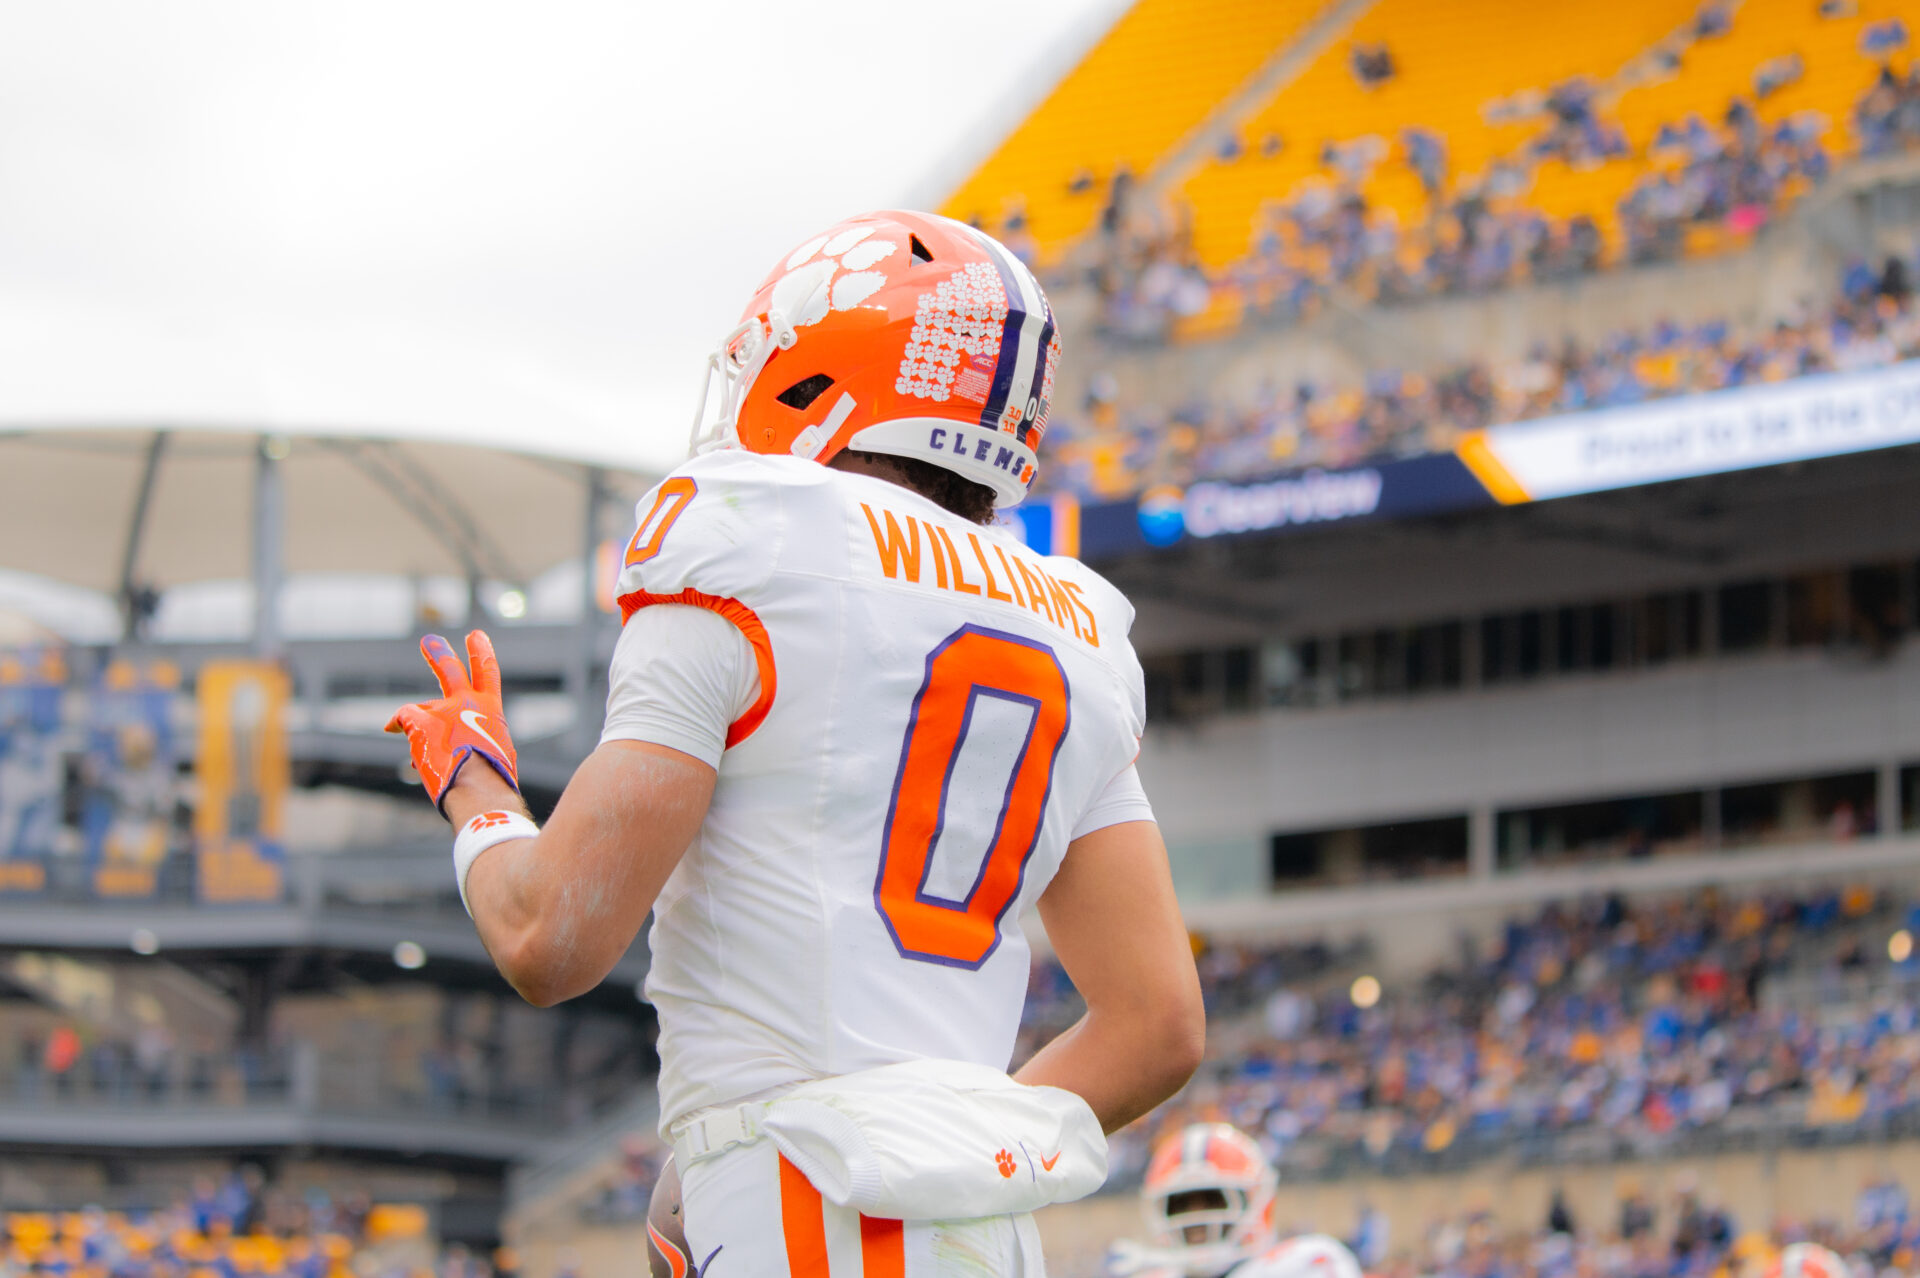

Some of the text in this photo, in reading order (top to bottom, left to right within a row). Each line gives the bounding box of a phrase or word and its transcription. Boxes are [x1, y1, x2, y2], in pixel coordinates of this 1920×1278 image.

[974, 357, 994, 368] ACC
[1025, 397, 1038, 422] 0
[625, 476, 698, 569] 0
[1184, 468, 1383, 538] Clearview
[861, 502, 1100, 648] WILLIAMS
[873, 622, 1071, 971] 0
